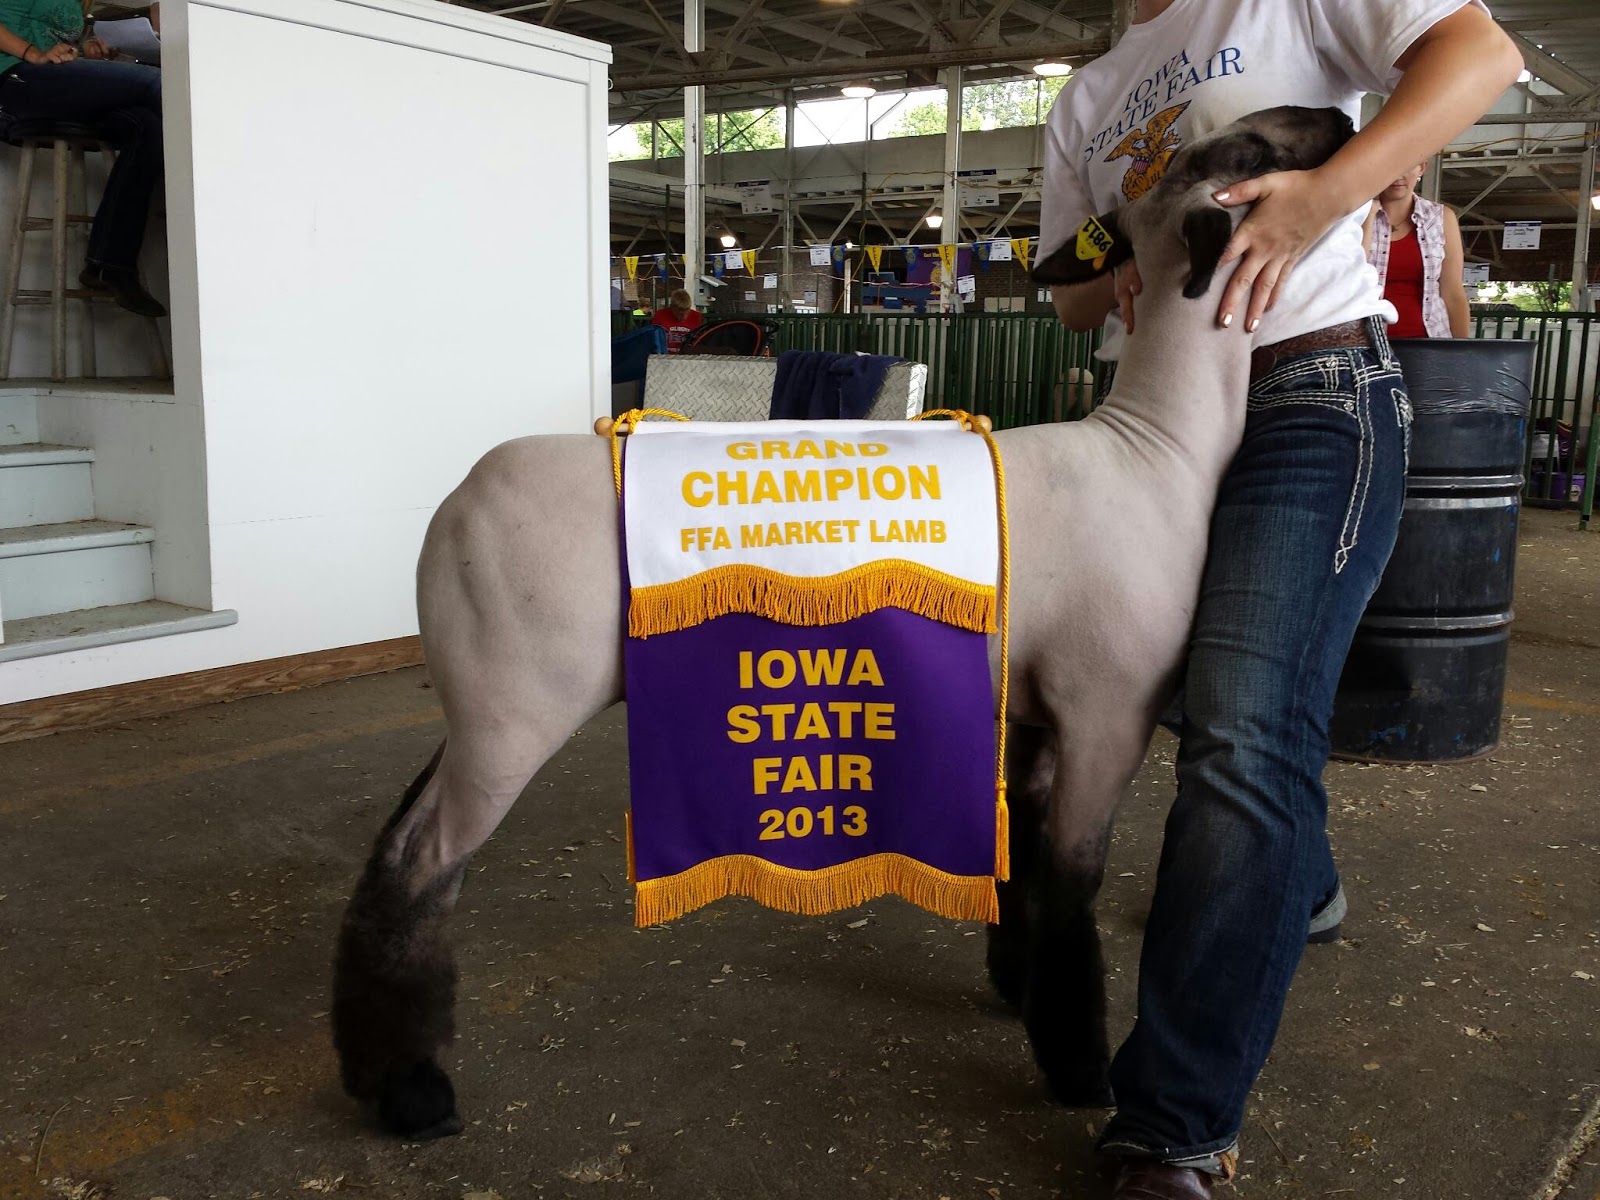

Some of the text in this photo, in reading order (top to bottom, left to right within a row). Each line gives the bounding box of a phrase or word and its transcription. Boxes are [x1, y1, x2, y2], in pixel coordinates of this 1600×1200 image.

[1124, 48, 1191, 113] IOWA
[1164, 46, 1245, 104] FAIR
[1018, 240, 1026, 259] FFA
[1082, 217, 1112, 253] 9811
[725, 440, 889, 460] GRAND
[681, 464, 942, 506] CHAMPION
[680, 519, 947, 553] FFA MARKET LAMB
[738, 649, 885, 689] IOWA
[726, 702, 896, 743] STATE
[752, 755, 874, 795] FAIR
[758, 806, 869, 840] 2013
